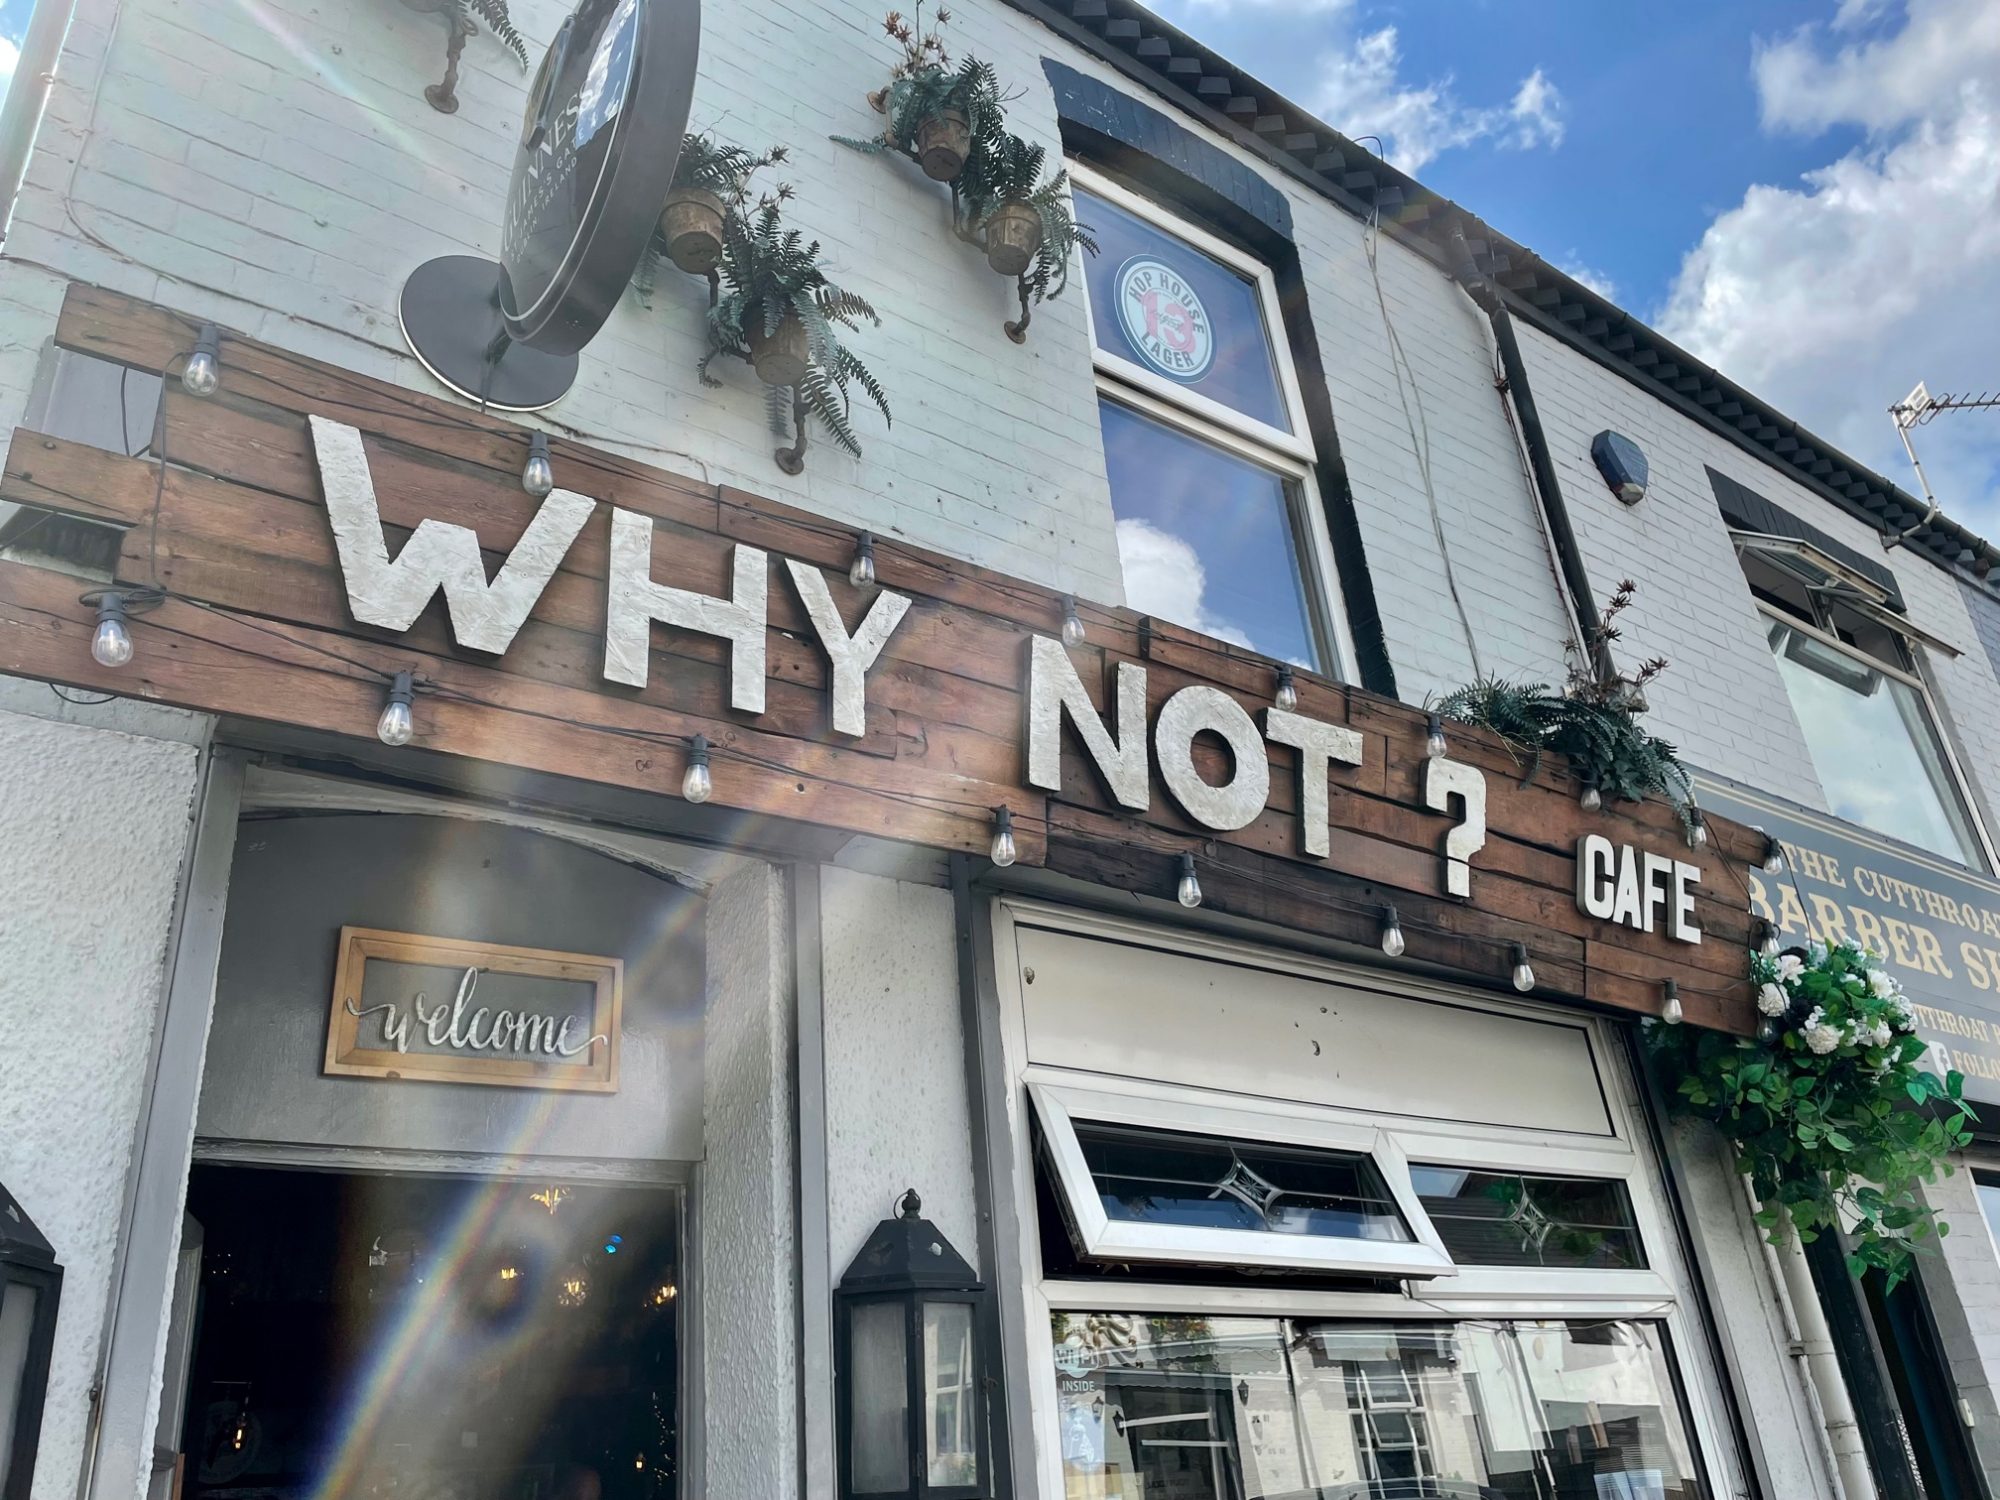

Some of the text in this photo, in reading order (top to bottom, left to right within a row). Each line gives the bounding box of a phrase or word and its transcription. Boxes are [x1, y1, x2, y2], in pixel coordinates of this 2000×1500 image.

[504, 81, 594, 251] GUINNESS
[1128, 271, 1153, 303] HOP
[1159, 272, 1205, 335] HOUSE
[1141, 289, 1197, 353] 13
[1141, 331, 1195, 368] LAGER
[307, 414, 912, 738] WHY
[1576, 833, 1703, 947] CAFE
[1778, 839, 2000, 943] THE CUTTHROA
[345, 966, 608, 1056] welcome
[1911, 1003, 1990, 1043] TTHROAT
[1062, 1380, 1096, 1392] INSIDE
